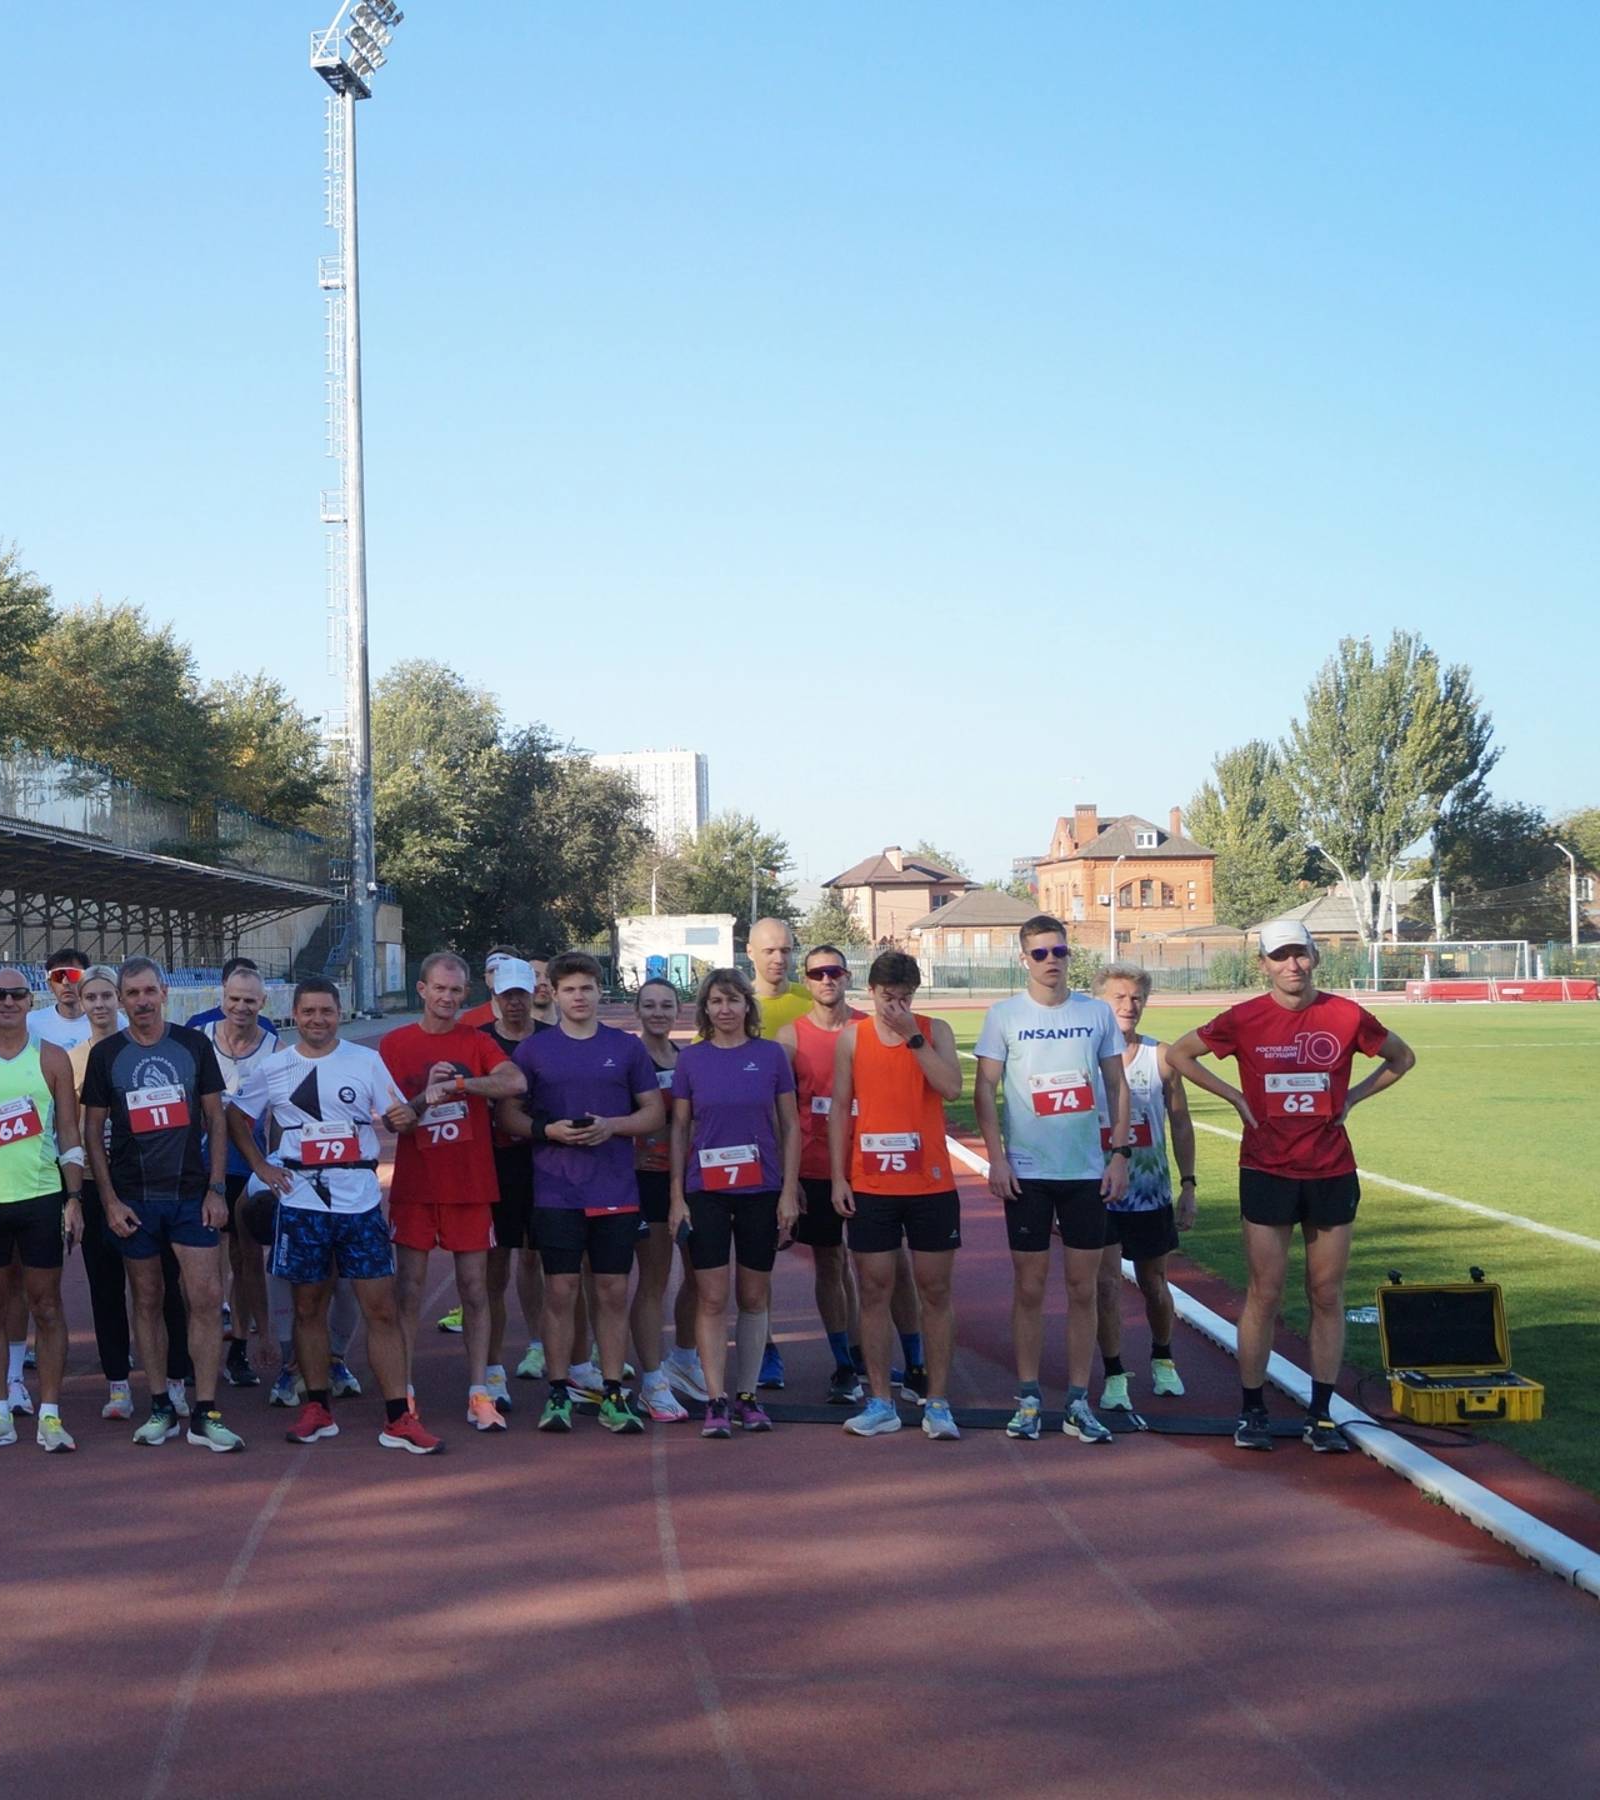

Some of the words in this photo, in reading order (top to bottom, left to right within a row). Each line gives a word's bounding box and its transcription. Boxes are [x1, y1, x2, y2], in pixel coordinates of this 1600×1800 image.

[1018, 1027, 1094, 1041] INSANITY
[1295, 1031, 1341, 1065] 10
[1048, 1090, 1079, 1112] 74
[1283, 1094, 1314, 1112] 62
[149, 1107, 169, 1127] 11
[0, 1117, 29, 1141] 64
[427, 1123, 460, 1144] 70
[315, 1141, 345, 1161] 79
[876, 1154, 907, 1172] 75
[724, 1166, 739, 1184] 7
